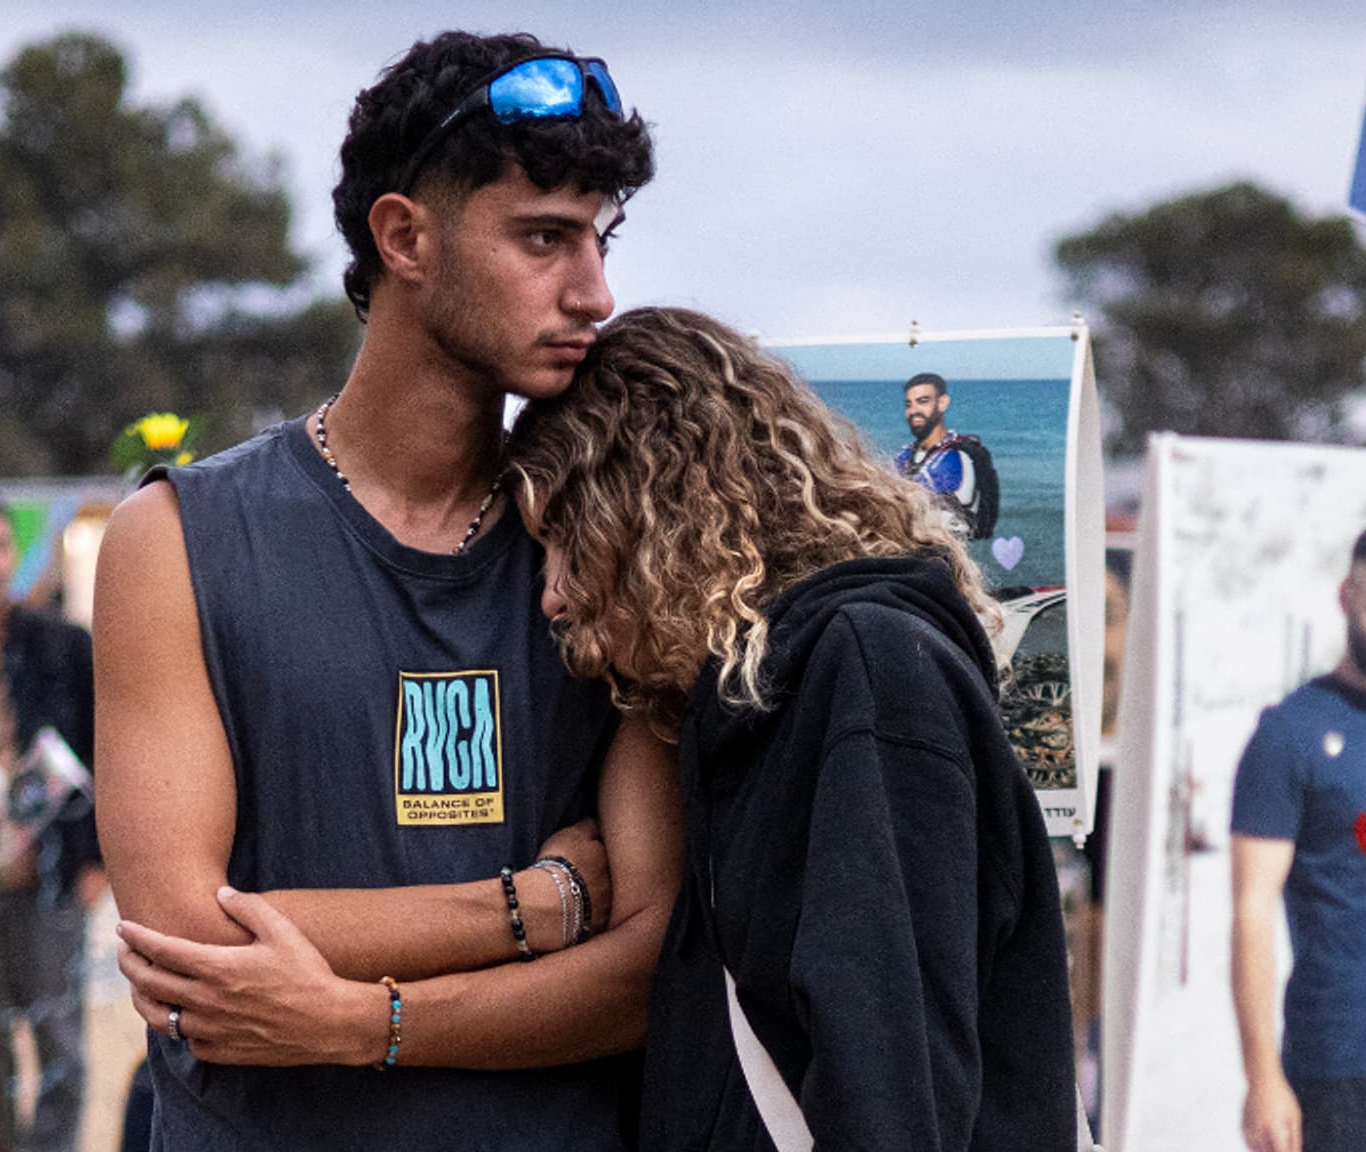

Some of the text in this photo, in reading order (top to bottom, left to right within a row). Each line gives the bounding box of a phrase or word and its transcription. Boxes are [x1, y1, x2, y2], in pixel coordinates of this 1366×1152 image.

[401, 678, 496, 791] RVCA
[402, 797, 494, 809] BALANCE OF
